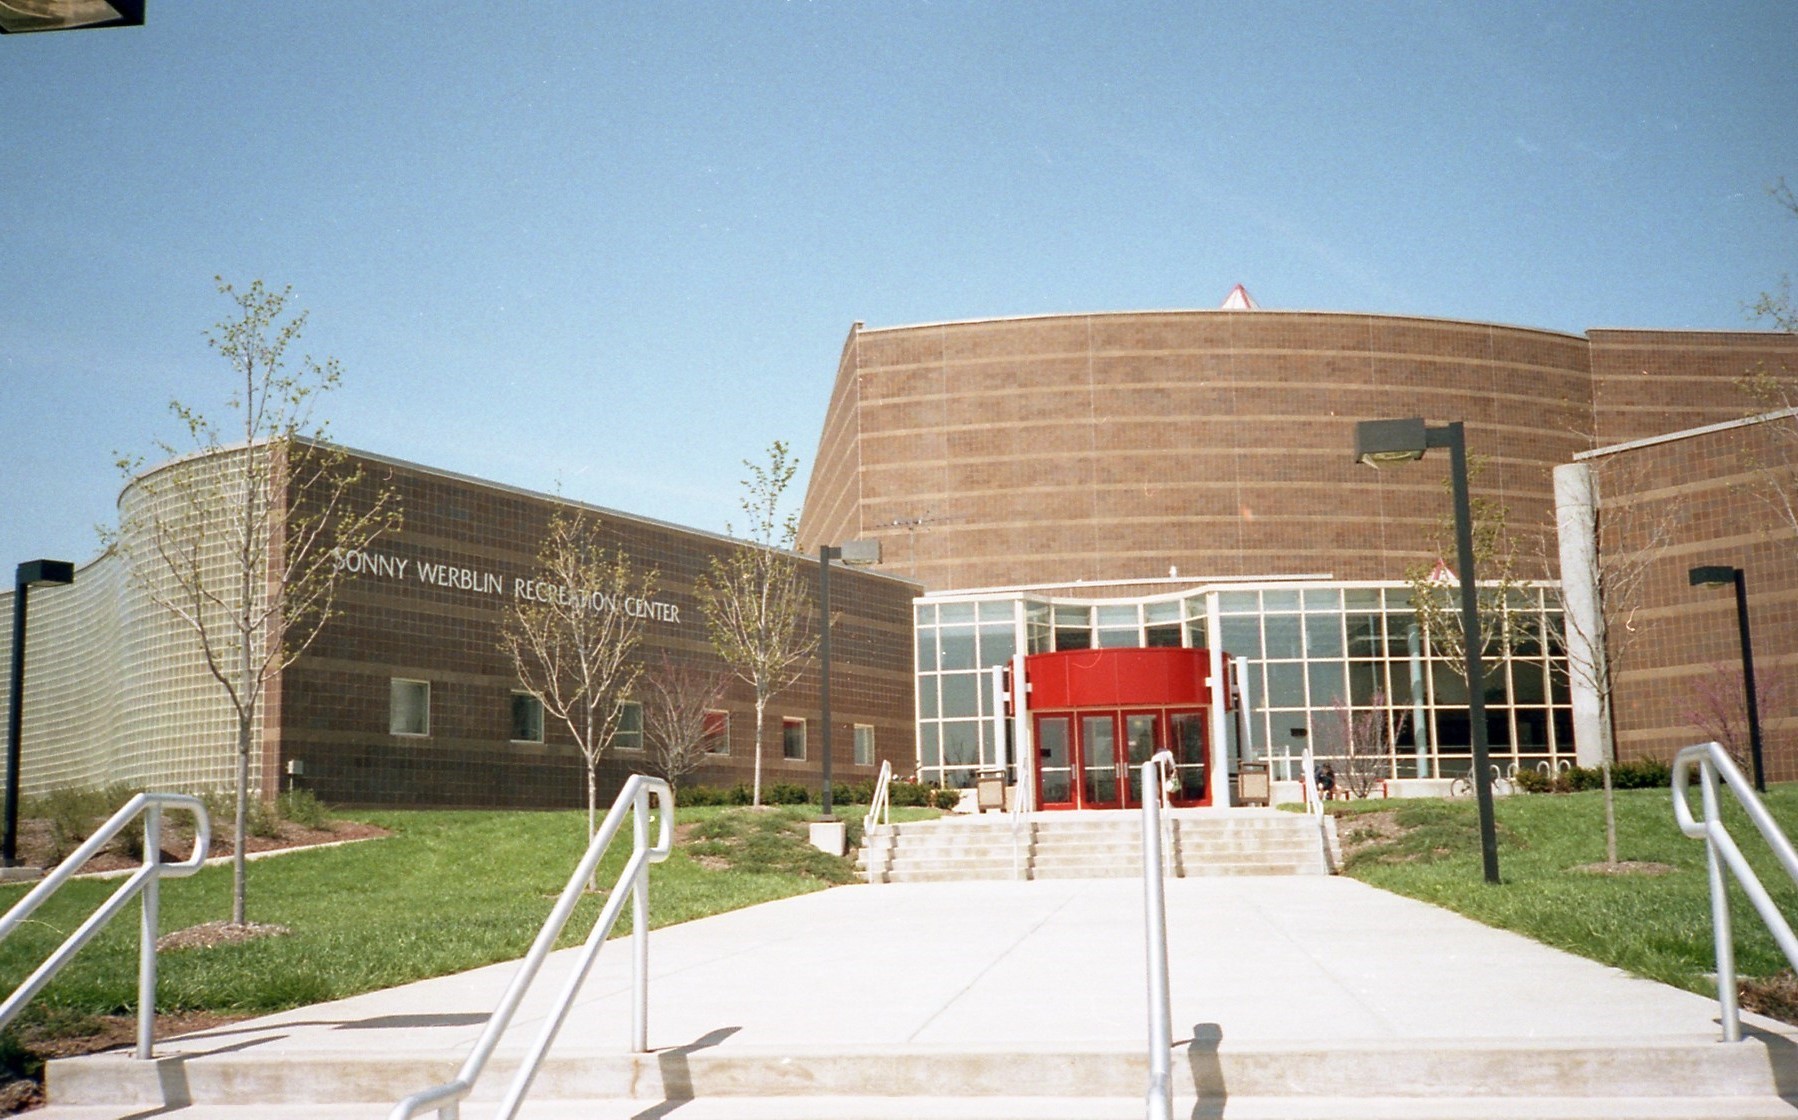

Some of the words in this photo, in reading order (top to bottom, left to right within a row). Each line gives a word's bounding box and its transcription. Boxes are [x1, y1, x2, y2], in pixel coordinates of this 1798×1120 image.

[333, 546, 408, 579] SONNY
[417, 561, 502, 595] WERBLIN
[624, 597, 680, 623] CENTER
